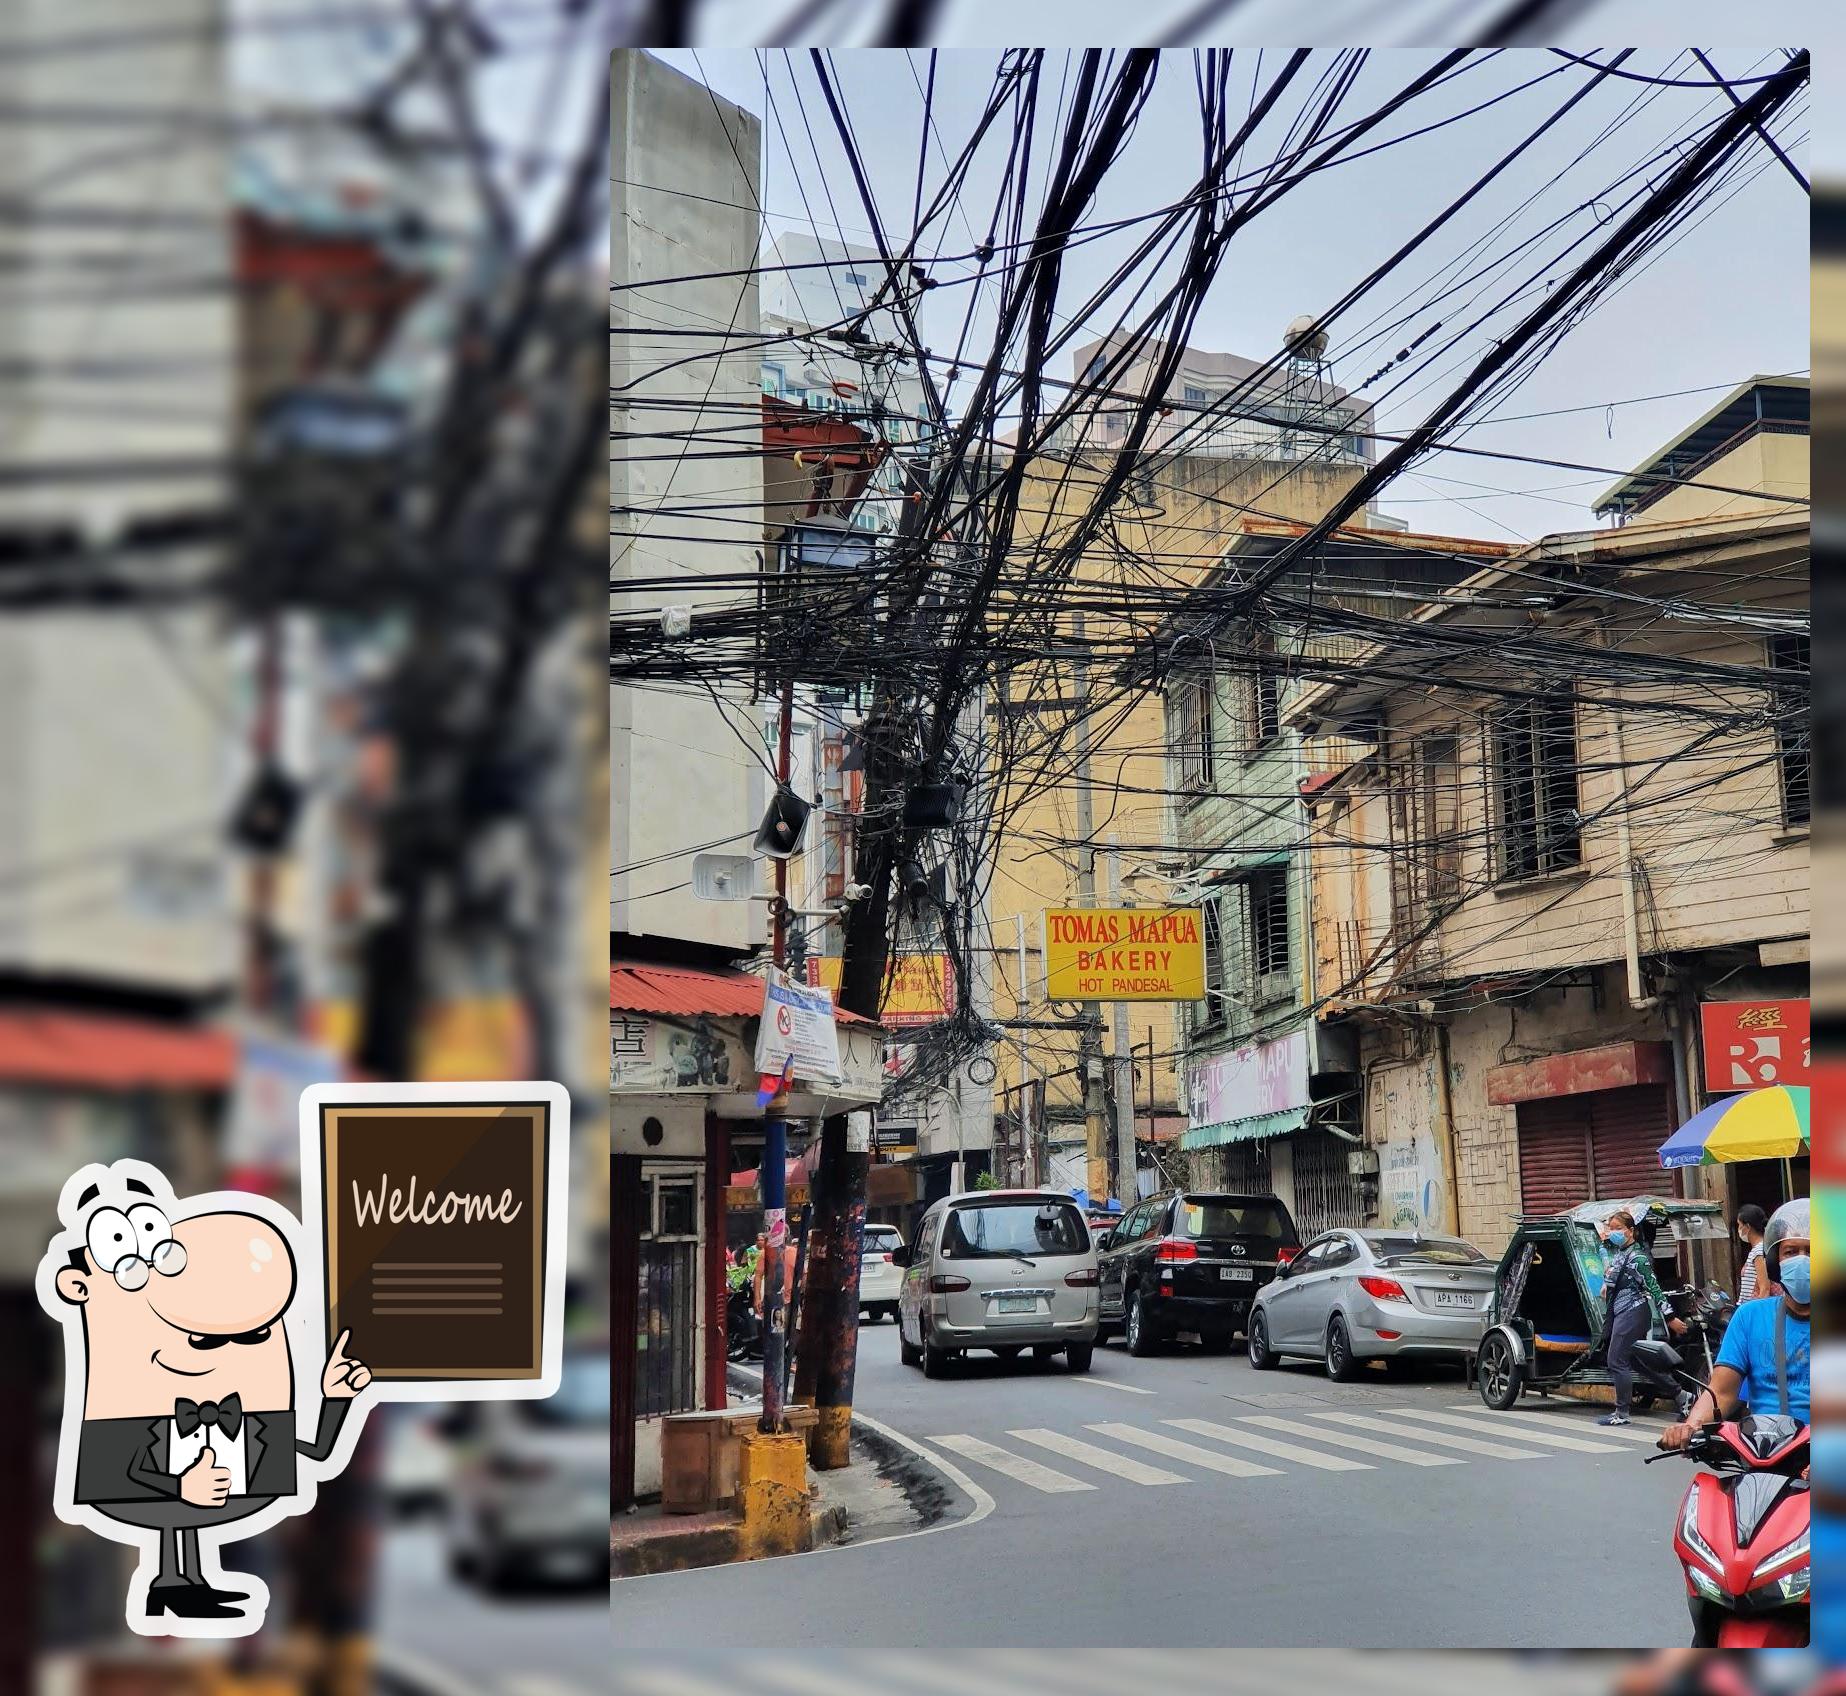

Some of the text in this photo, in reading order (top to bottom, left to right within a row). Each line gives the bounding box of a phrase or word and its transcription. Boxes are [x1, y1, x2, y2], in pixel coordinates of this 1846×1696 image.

[1050, 915, 1199, 944] TOMAS MAPUA
[1078, 950, 1172, 971] BAKERY
[1079, 978, 1174, 993] HOT PANDESAL
